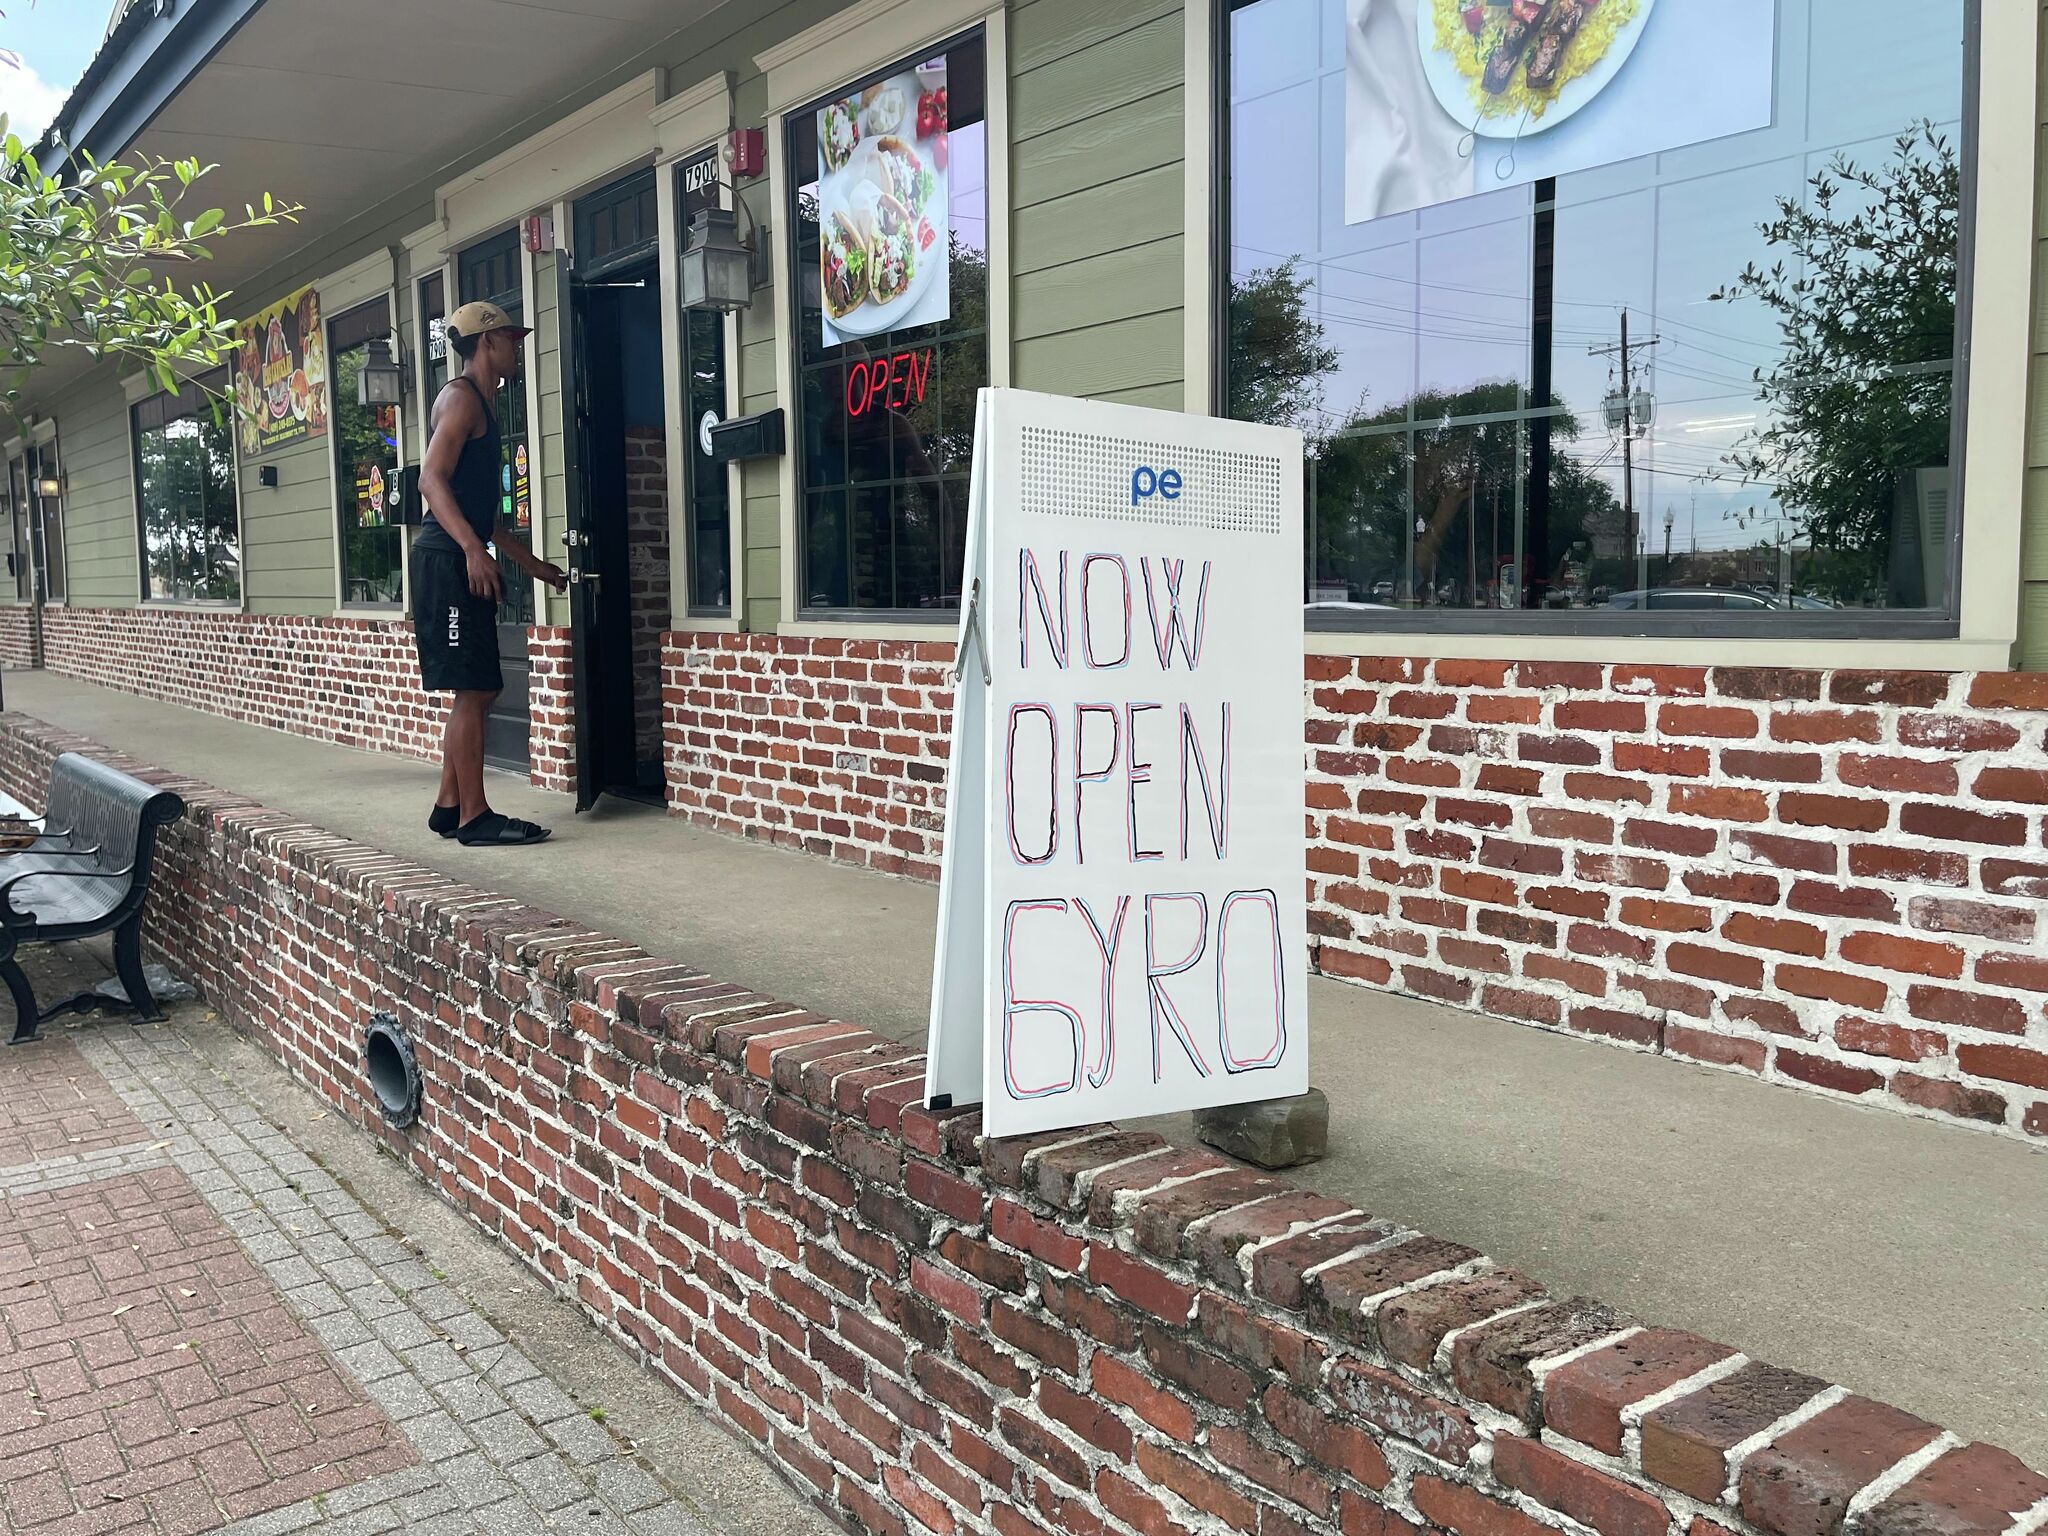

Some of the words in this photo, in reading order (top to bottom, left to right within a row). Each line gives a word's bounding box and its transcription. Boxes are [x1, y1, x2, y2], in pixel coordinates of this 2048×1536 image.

[687, 158, 717, 191] 790C
[847, 347, 932, 416] OPEN
[1131, 466, 1183, 507] pe
[448, 606, 459, 646] AND1
[1019, 547, 1212, 671] NOW
[1005, 702, 1231, 866] OPEN
[1003, 888, 1286, 1100] GYRO
